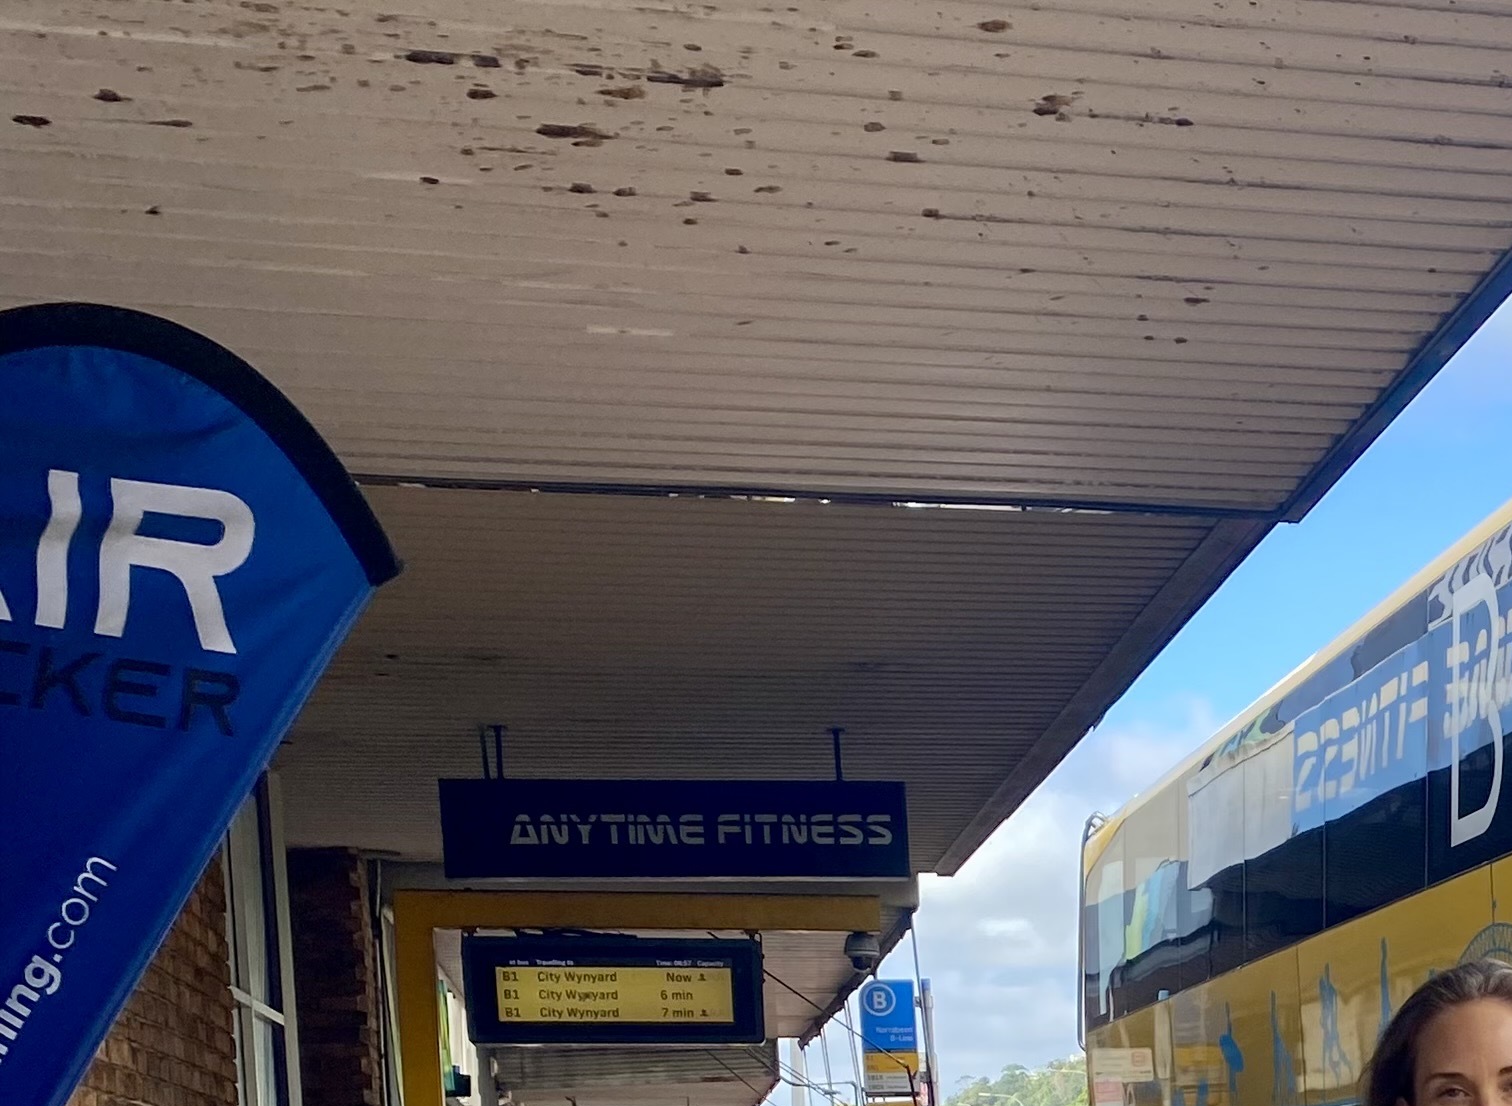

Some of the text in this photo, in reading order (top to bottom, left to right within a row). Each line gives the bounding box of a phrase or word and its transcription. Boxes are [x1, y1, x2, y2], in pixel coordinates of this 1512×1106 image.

[0, 469, 255, 654] IR
[509, 814, 893, 845] ANYTIME FITNESS
[502, 971, 519, 982] B1
[537, 971, 618, 984] City Wynyard
[666, 972, 692, 983] Now
[503, 989, 519, 1000] B1
[538, 989, 619, 1002] City Wynyard
[660, 990, 693, 1000] 6 min
[872, 991, 887, 1010] B
[505, 1007, 521, 1018] B1
[539, 1007, 620, 1020] City Wynyard
[661, 1007, 694, 1018] 7 min
